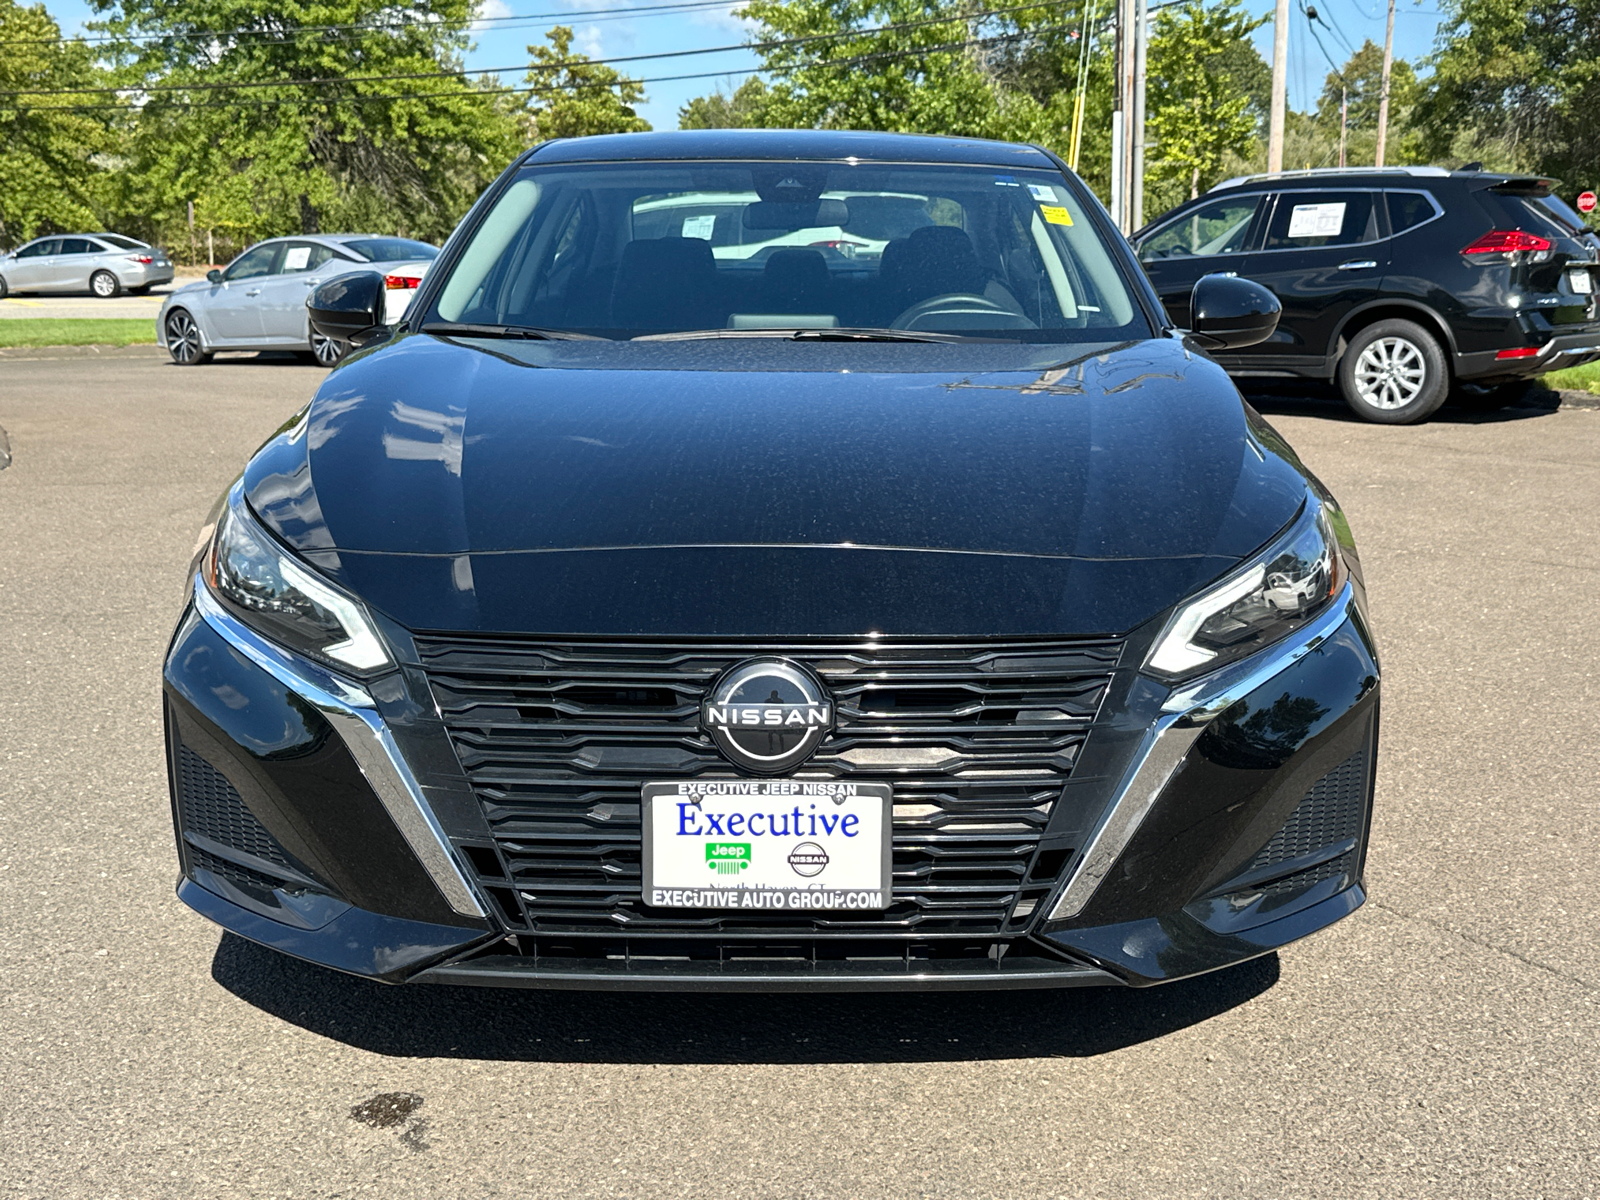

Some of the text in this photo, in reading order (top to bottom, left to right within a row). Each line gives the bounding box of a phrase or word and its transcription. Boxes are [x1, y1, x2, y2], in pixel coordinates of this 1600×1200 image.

[708, 707, 828, 725] NISSAN
[678, 784, 857, 796] EXECUTIVE JEEP NISSAN
[676, 802, 860, 837] Executive
[711, 844, 746, 858] Jeep
[790, 856, 827, 864] NISSAN
[652, 890, 882, 908] EXECUTIVE AUTO GROUP.COM
